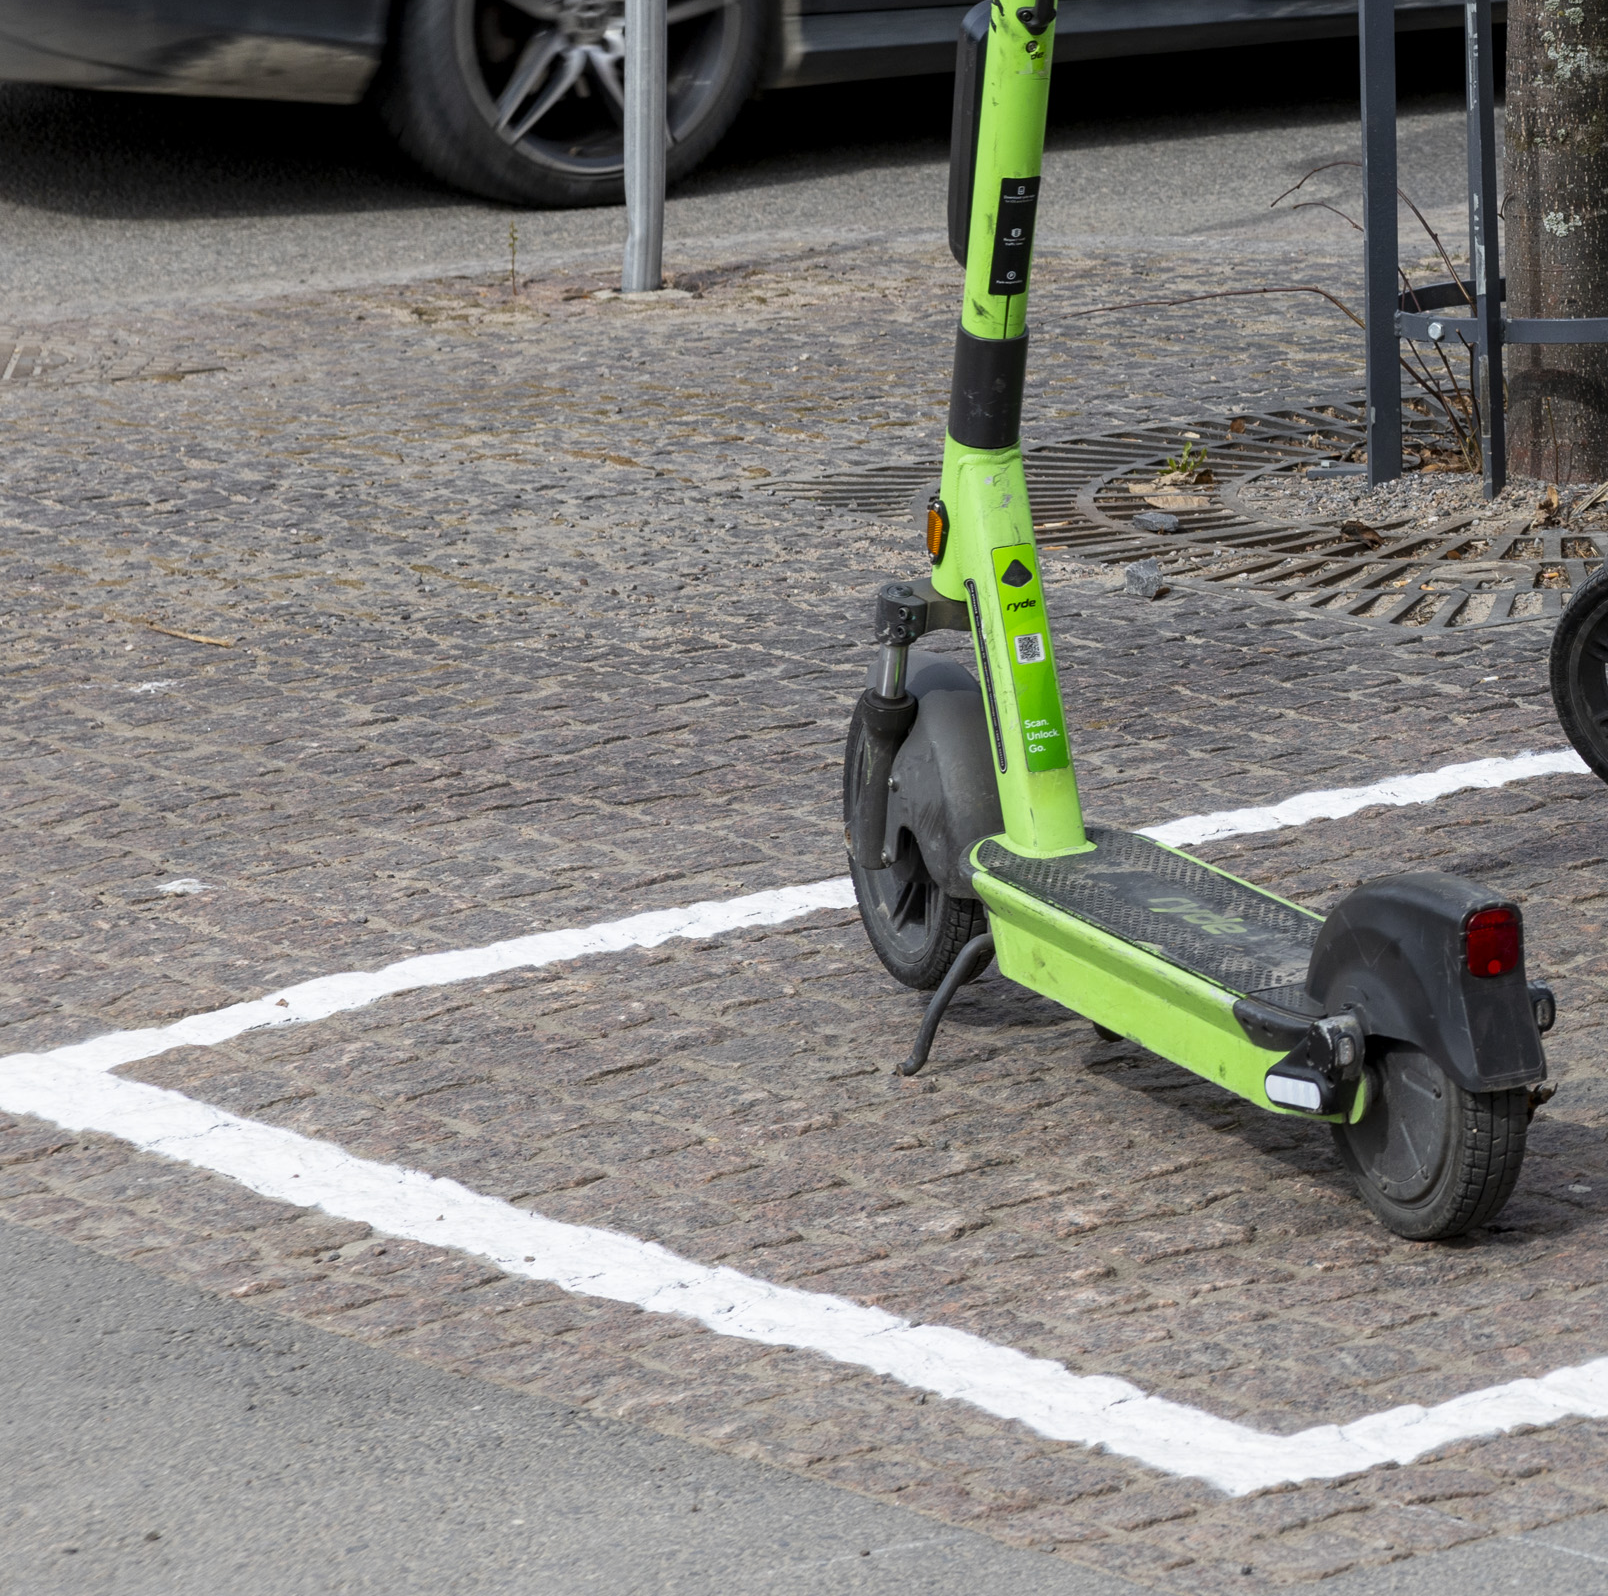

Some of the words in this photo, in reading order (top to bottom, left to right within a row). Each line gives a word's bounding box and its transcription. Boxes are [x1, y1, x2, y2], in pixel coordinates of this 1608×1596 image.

[1006, 598, 1036, 612] ryde
[1024, 719, 1049, 729] Scan.
[1026, 729, 1060, 741] Unlock.
[1029, 743, 1046, 754] Go.
[1146, 897, 1248, 935] ryde
